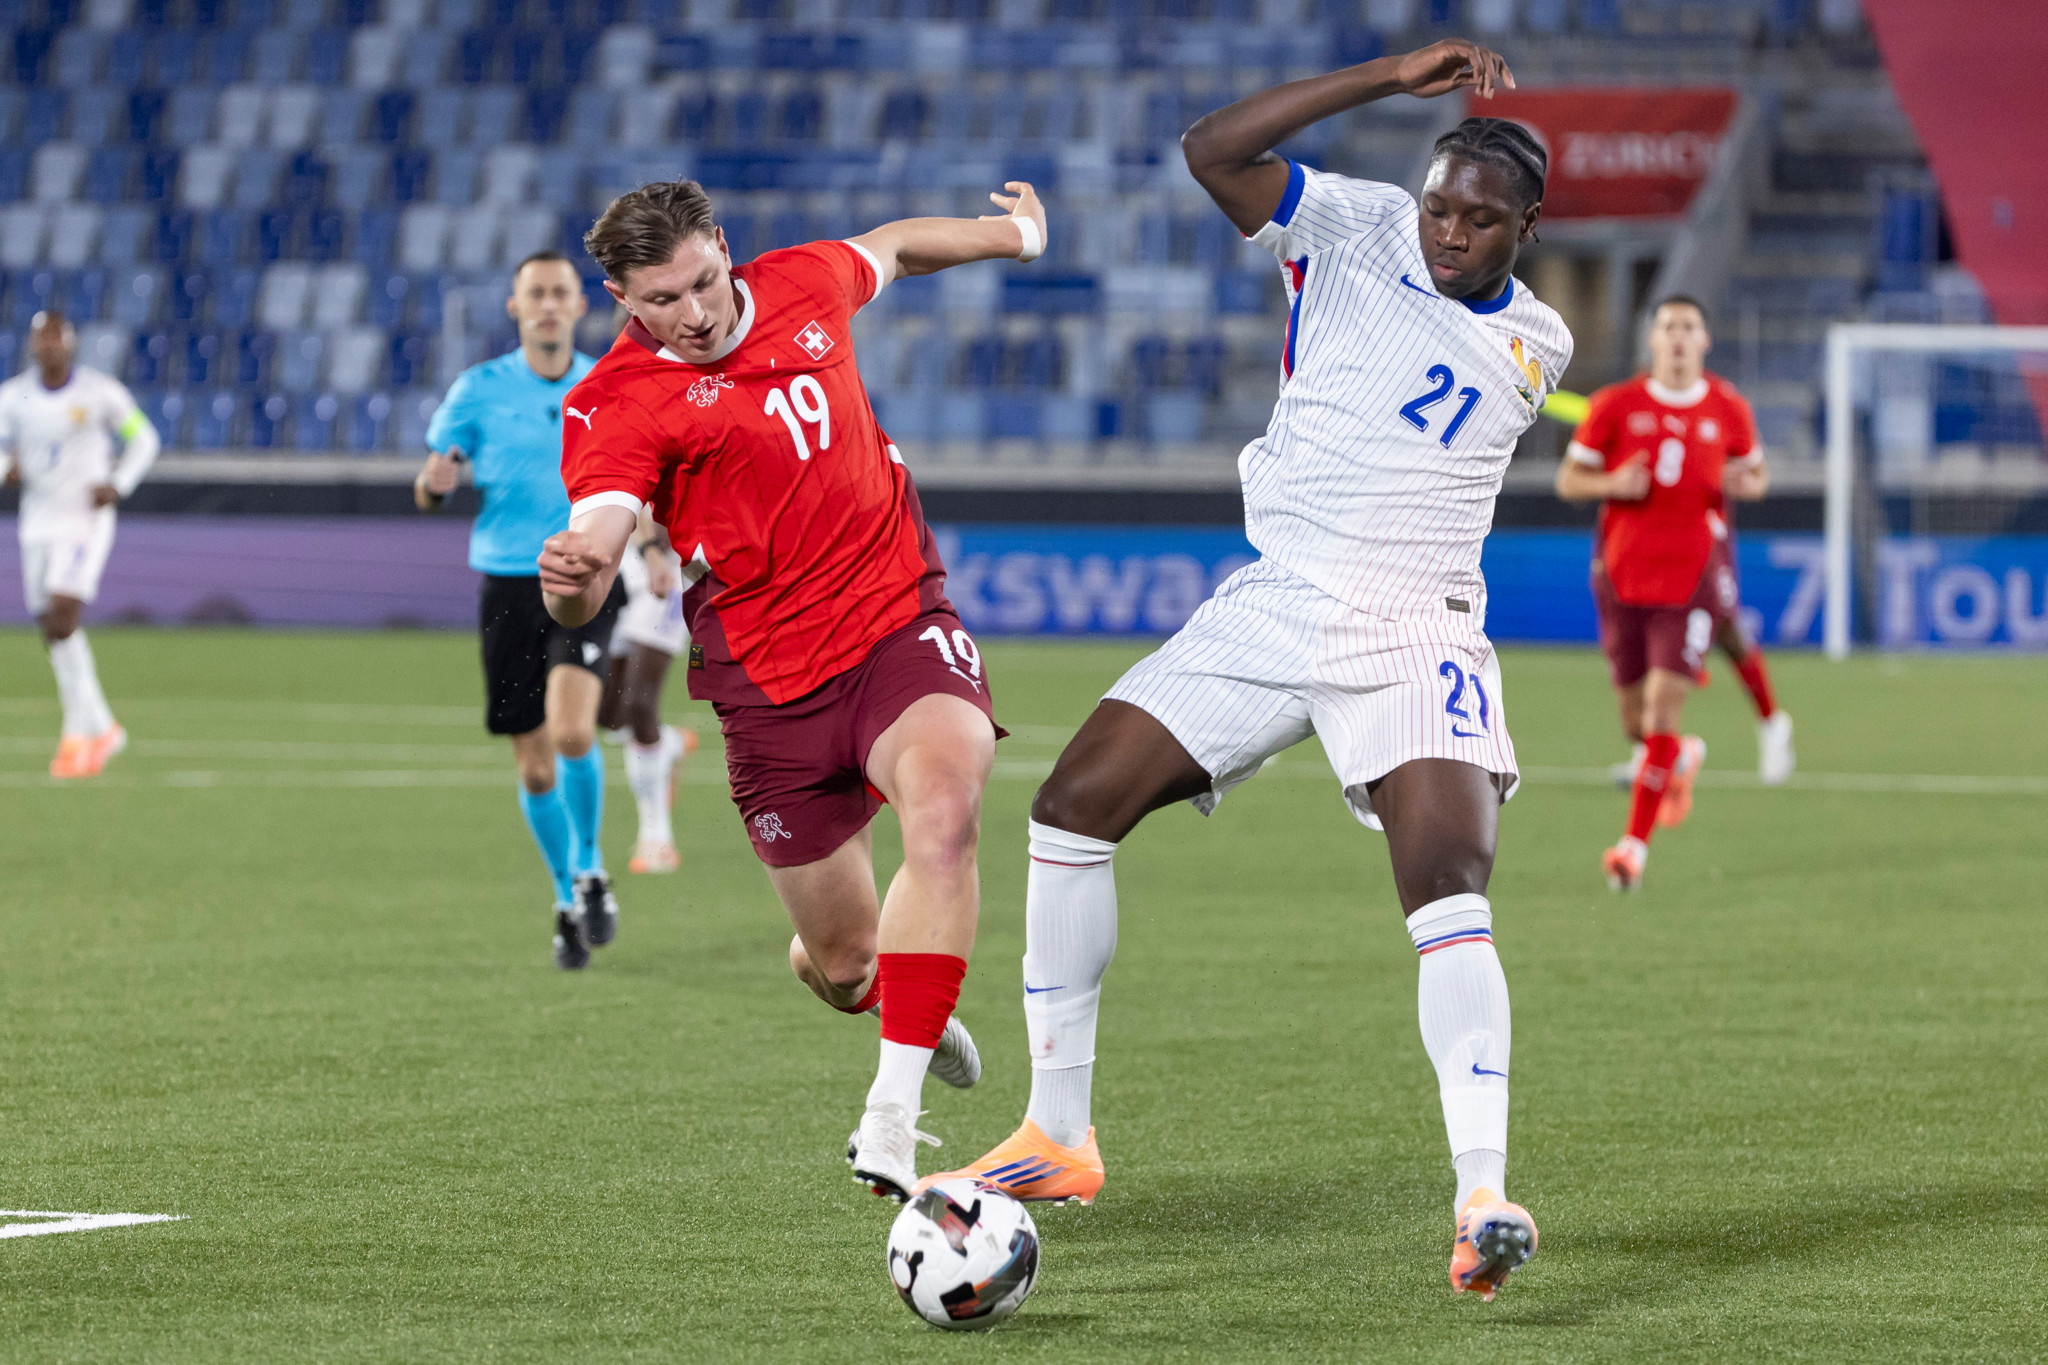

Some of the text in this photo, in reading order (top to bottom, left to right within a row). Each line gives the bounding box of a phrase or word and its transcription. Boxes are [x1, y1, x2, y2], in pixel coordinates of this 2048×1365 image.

[764, 375, 830, 460] 19
[1399, 364, 1482, 449] 21
[919, 625, 980, 678] 19
[1439, 660, 1490, 733] 21
